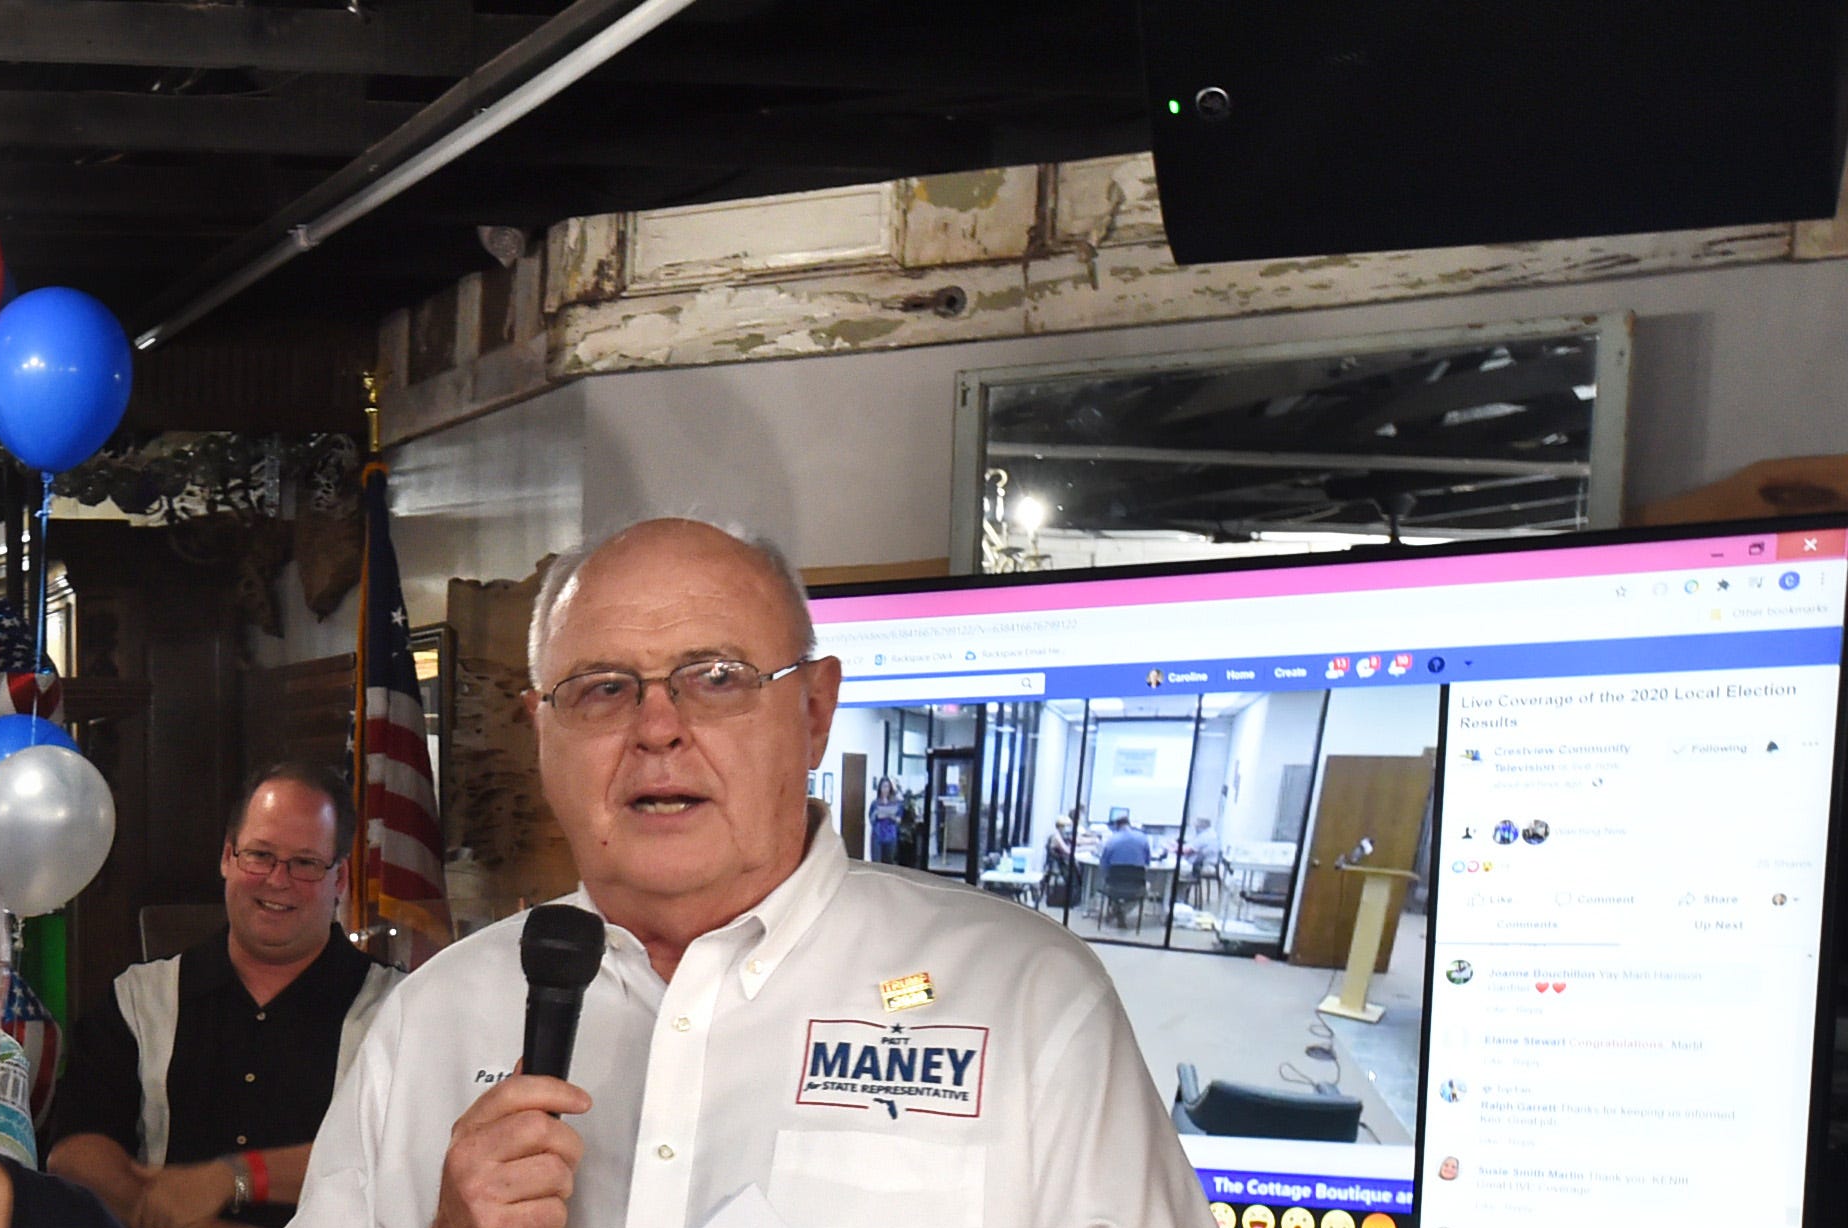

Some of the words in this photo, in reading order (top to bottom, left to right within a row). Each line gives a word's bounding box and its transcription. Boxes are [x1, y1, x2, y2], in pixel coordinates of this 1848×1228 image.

[1168, 671, 1208, 683] Caroline
[1226, 669, 1256, 680] Home
[1274, 666, 1307, 679] Create
[1461, 695, 1493, 710] Live
[1498, 692, 1573, 712] Coverage
[1578, 691, 1593, 705] of
[1598, 689, 1626, 704] the
[1630, 688, 1669, 703] 2020
[1675, 686, 1720, 701] Local
[1725, 682, 1798, 699] Election
[1460, 716, 1519, 731] Results
[1494, 743, 1555, 756] Crestview
[1558, 742, 1632, 758] Community
[1692, 742, 1748, 757] Following
[1493, 763, 1555, 774] Television
[1490, 894, 1513, 904] Like
[1578, 895, 1635, 904] Comment
[1703, 895, 1739, 905] Share
[1496, 920, 1559, 930] Comments
[1695, 920, 1712, 931] Up
[1715, 919, 1744, 930] Next
[1489, 968, 1529, 980] Joanne
[880, 1037, 912, 1045] PATT
[1484, 1035, 1519, 1047] Elaine
[1523, 1036, 1566, 1047] Stewart
[808, 1041, 977, 1087] MANEY
[475, 1069, 513, 1083] Pat
[803, 1082, 822, 1092] for
[822, 1081, 858, 1094] STATE
[860, 1083, 970, 1102] REPRESENTATIVE
[1480, 1100, 1514, 1113] Ralph
[1516, 1102, 1557, 1113] Garrett
[1559, 1102, 1599, 1115] Thanks
[1620, 1106, 1665, 1120] keeping
[1684, 1108, 1736, 1120] informed
[1478, 1165, 1509, 1177] Susie
[1512, 1167, 1544, 1178] Smith
[1548, 1169, 1584, 1181] Martin
[1213, 1175, 1245, 1195] The
[1246, 1179, 1312, 1202] Cottage
[1315, 1183, 1394, 1206] Boutique
